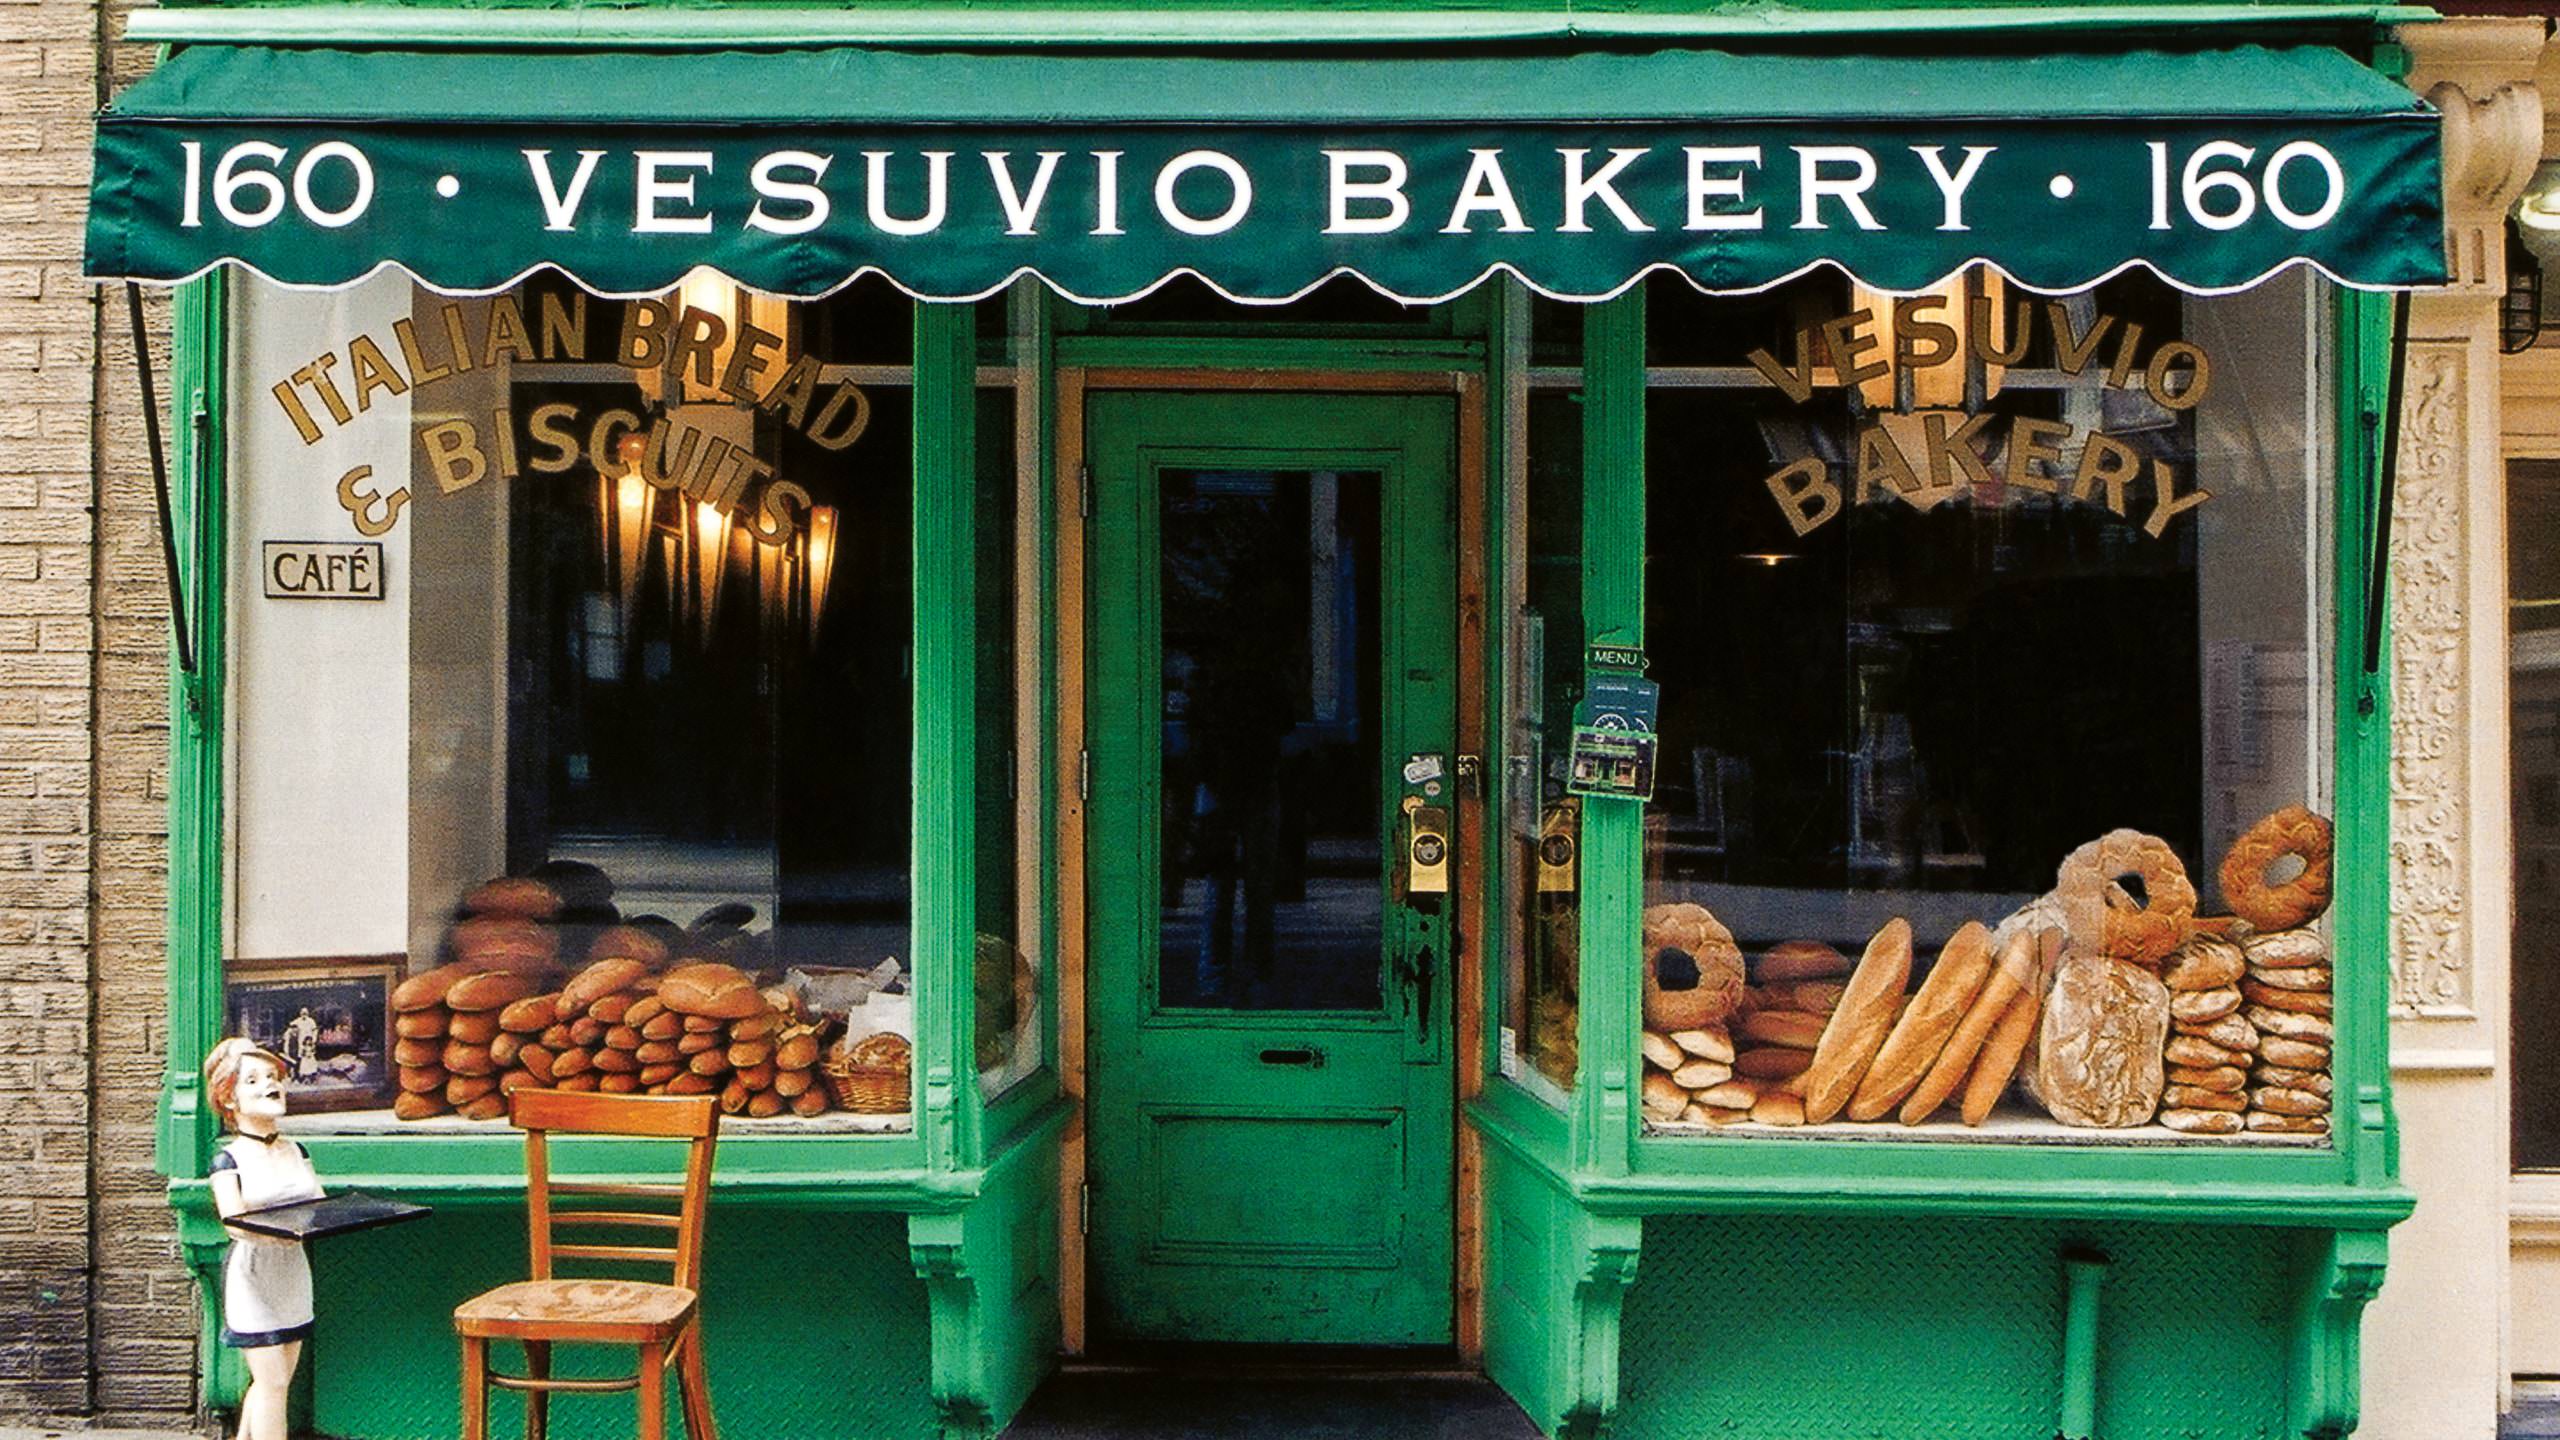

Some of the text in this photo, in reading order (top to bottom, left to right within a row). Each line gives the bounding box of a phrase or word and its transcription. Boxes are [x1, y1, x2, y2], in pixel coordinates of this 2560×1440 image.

[180, 140, 2345, 236] 160 VESUVIO BAKERY 160
[271, 292, 871, 451] ITALIAN BREAD
[1746, 294, 2211, 411] VESUVIO
[336, 403, 812, 547] & BISCUITS
[1765, 410, 2214, 540] BAKERY
[273, 547, 372, 593] CAFÉ
[1594, 650, 1638, 666] MENU
